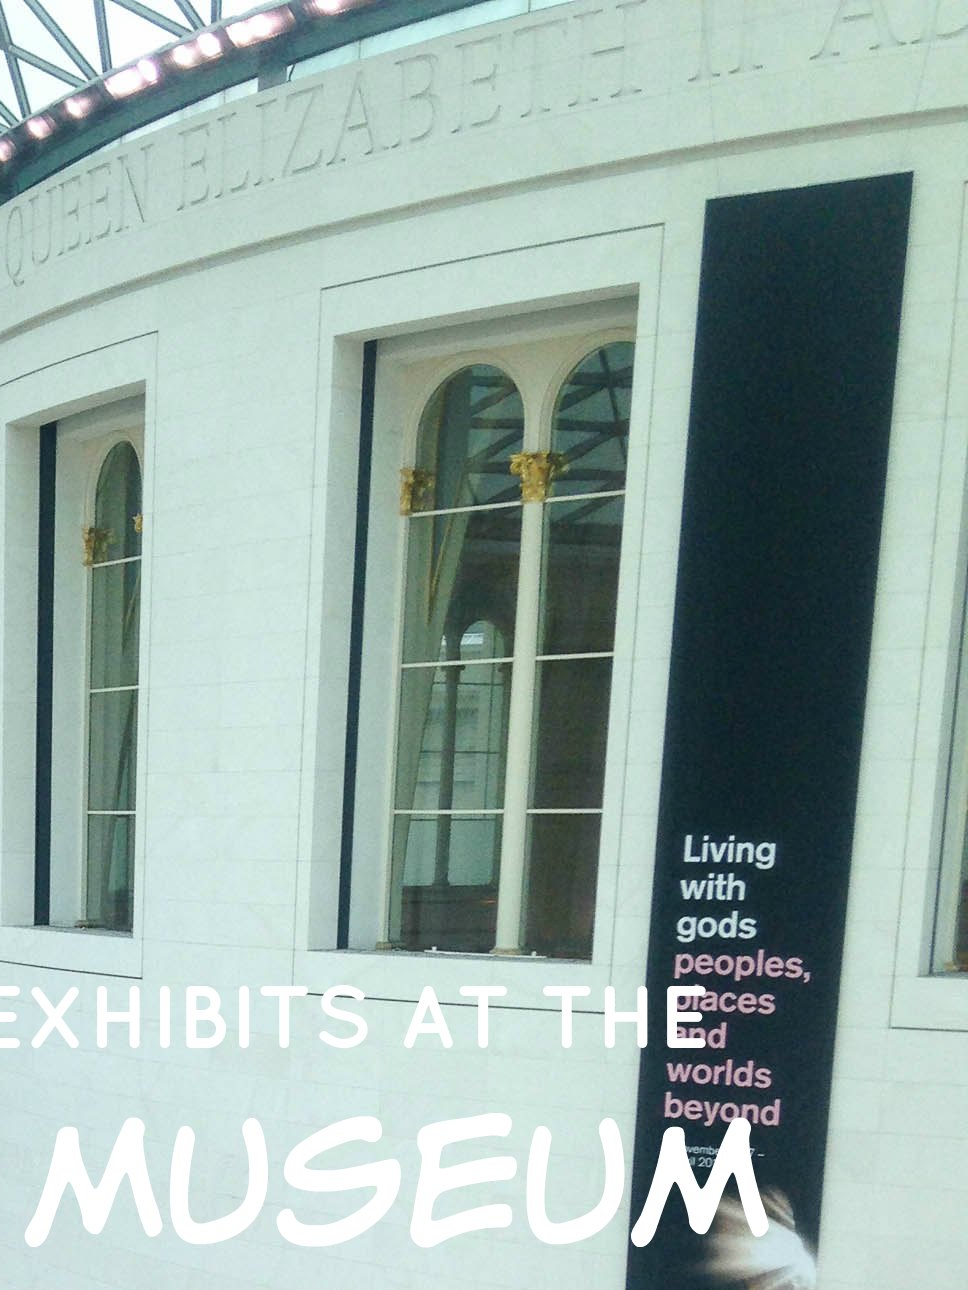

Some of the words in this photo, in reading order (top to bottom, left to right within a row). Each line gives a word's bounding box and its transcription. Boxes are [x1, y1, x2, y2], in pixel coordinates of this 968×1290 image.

[6, 144, 156, 288] QUEEN
[177, 0, 649, 211] ELIZABETH
[683, 834, 776, 870] Living
[680, 873, 746, 901] with
[676, 911, 757, 943] gods
[673, 950, 811, 983] peoples,
[667, 1059, 772, 1088] worlds
[664, 1092, 782, 1126] beyond
